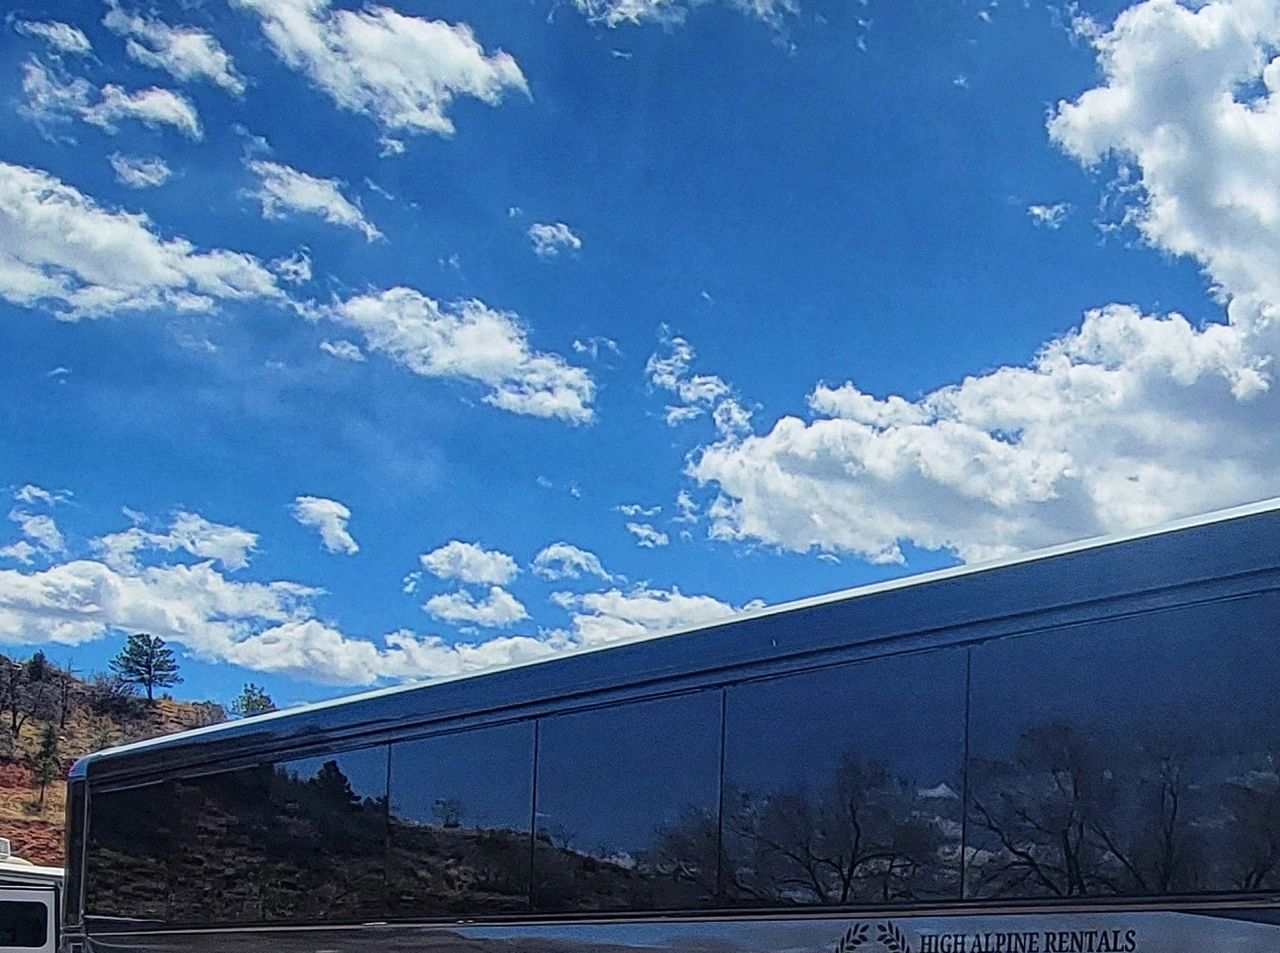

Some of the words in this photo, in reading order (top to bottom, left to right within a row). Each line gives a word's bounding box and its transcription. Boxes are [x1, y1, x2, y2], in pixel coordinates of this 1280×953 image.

[920, 934, 966, 953] HIGH
[970, 932, 1039, 953] ALPINE
[1043, 929, 1136, 953] RENTALS
